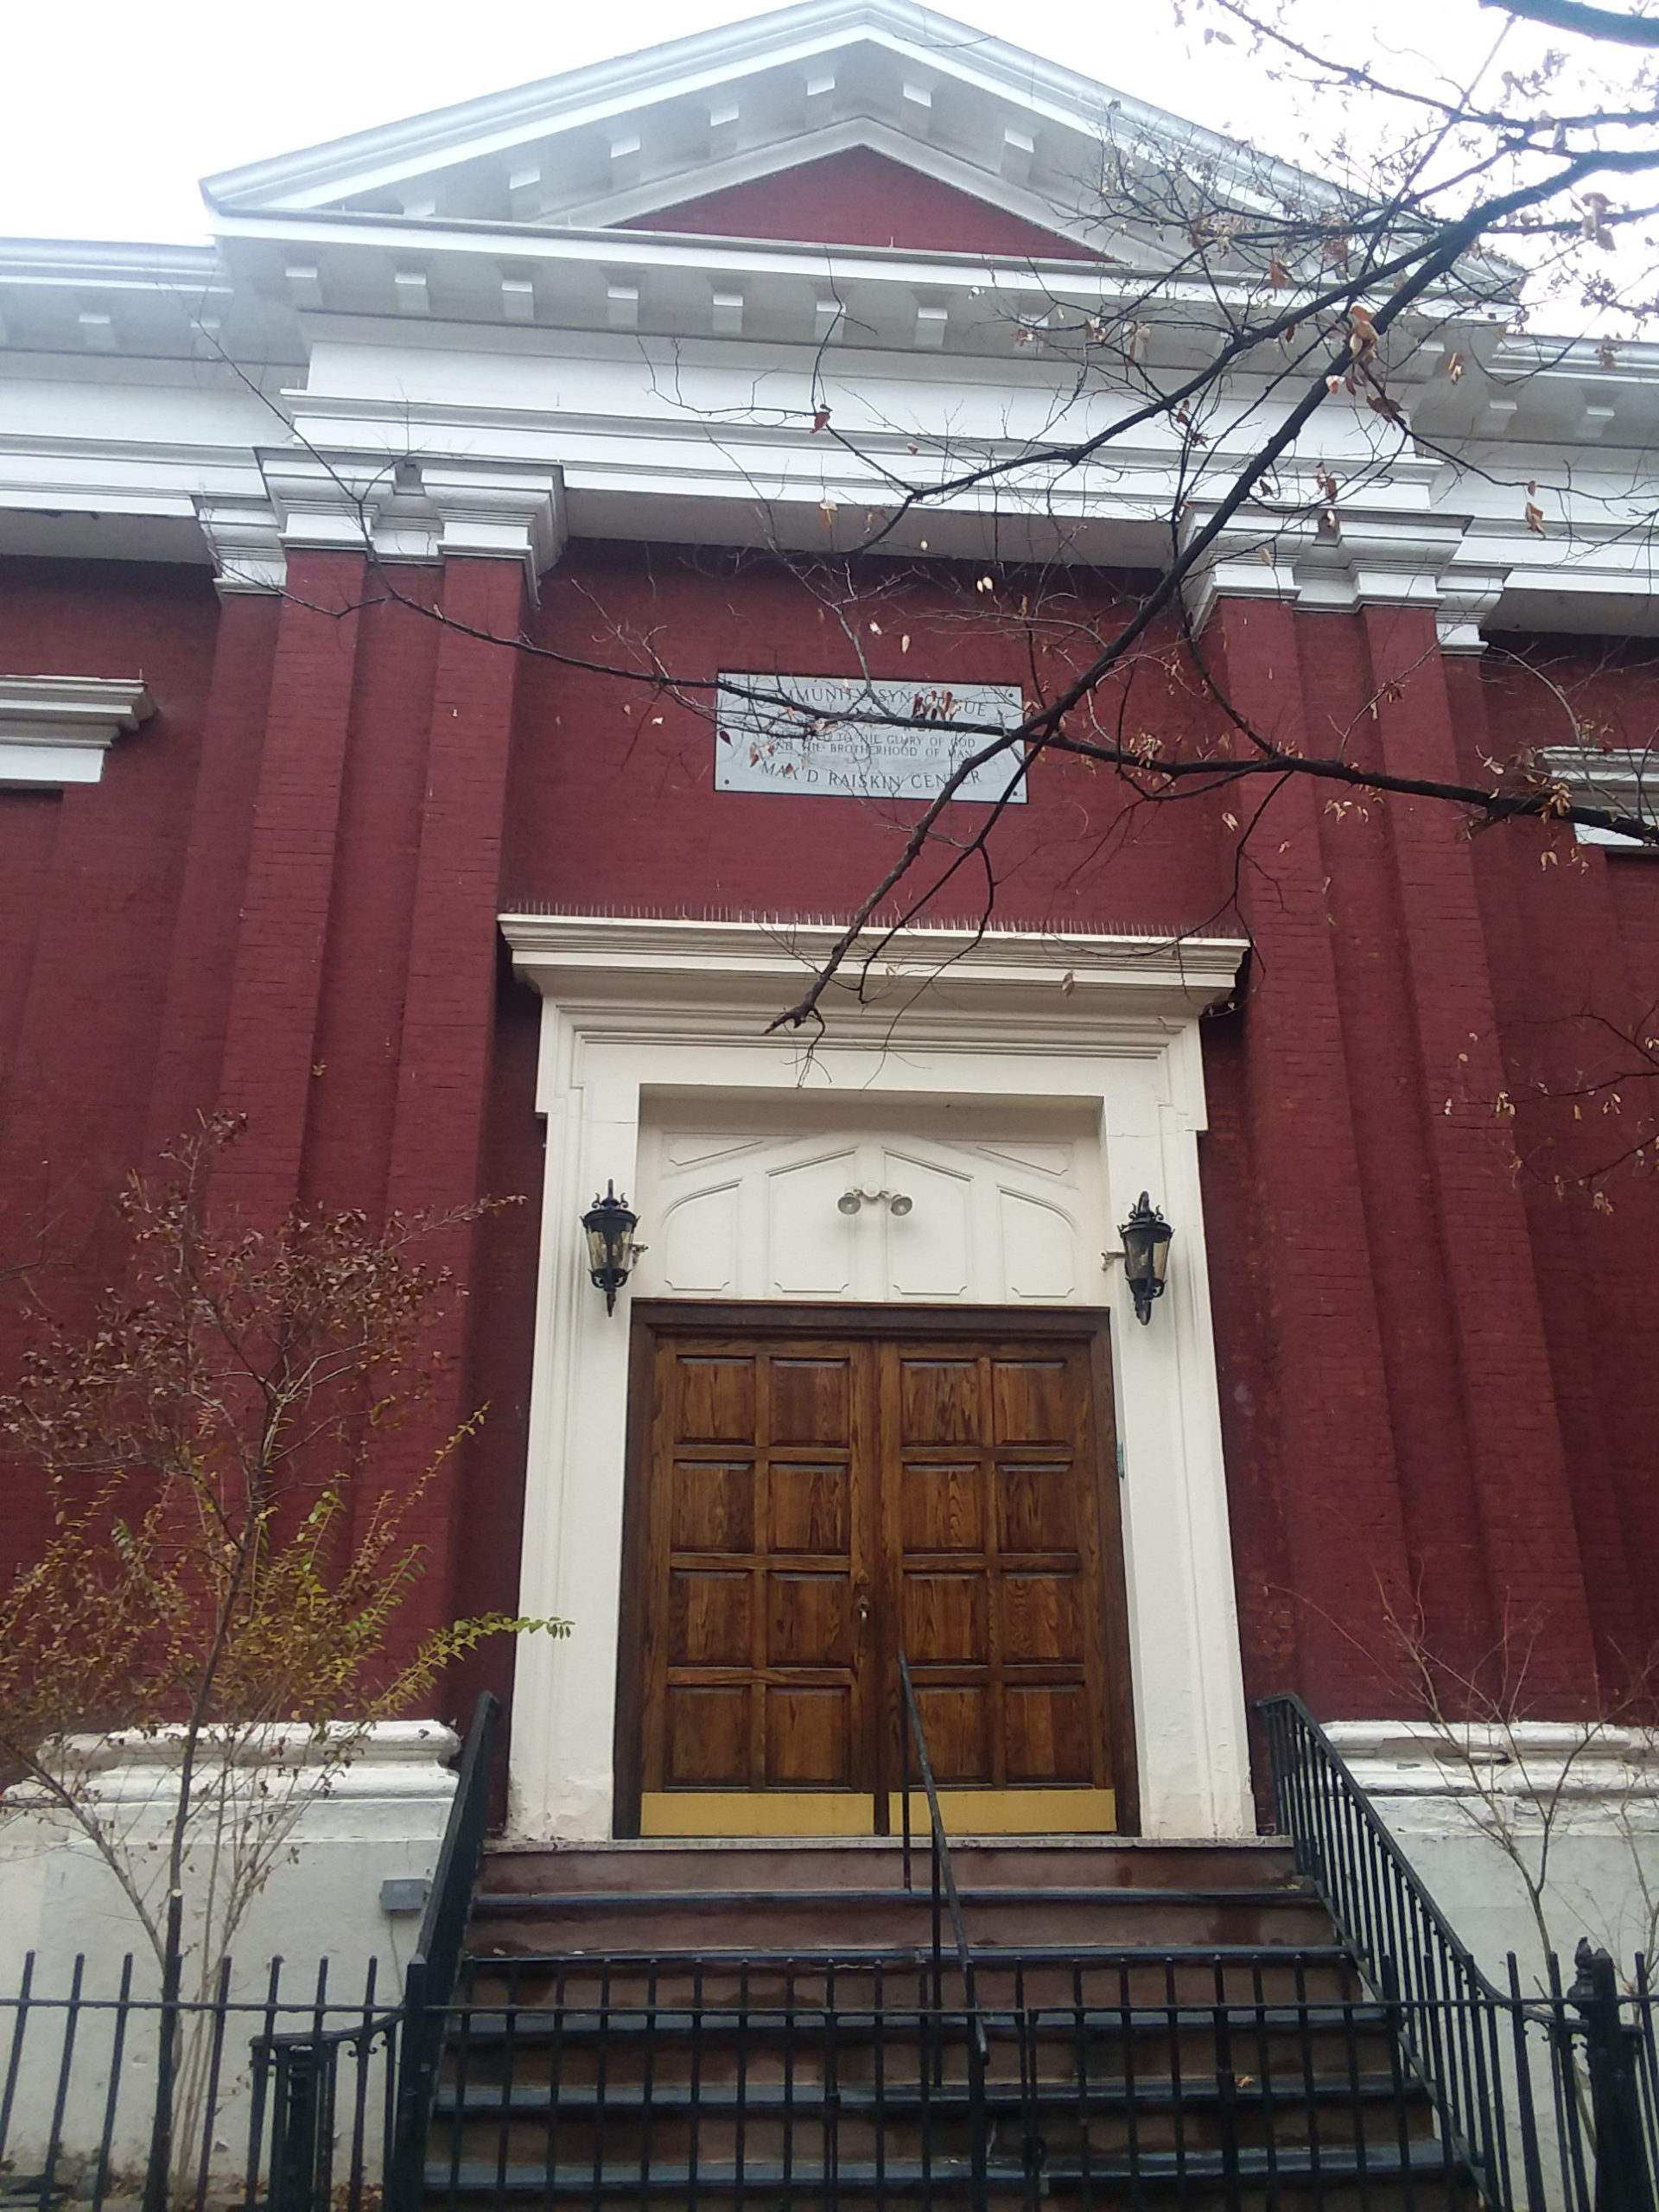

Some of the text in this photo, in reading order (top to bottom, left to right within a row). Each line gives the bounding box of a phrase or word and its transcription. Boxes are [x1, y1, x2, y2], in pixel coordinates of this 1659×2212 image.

[755, 688, 986, 716] MUNITY SYNGUE
[830, 743, 918, 756] BROTHERHOOD
[925, 747, 940, 758] OF
[930, 737, 944, 747] OF
[950, 738, 976, 749] GOD
[807, 769, 819, 783] D
[829, 772, 900, 790] RAISKIN
[911, 771, 982, 790] CENR
